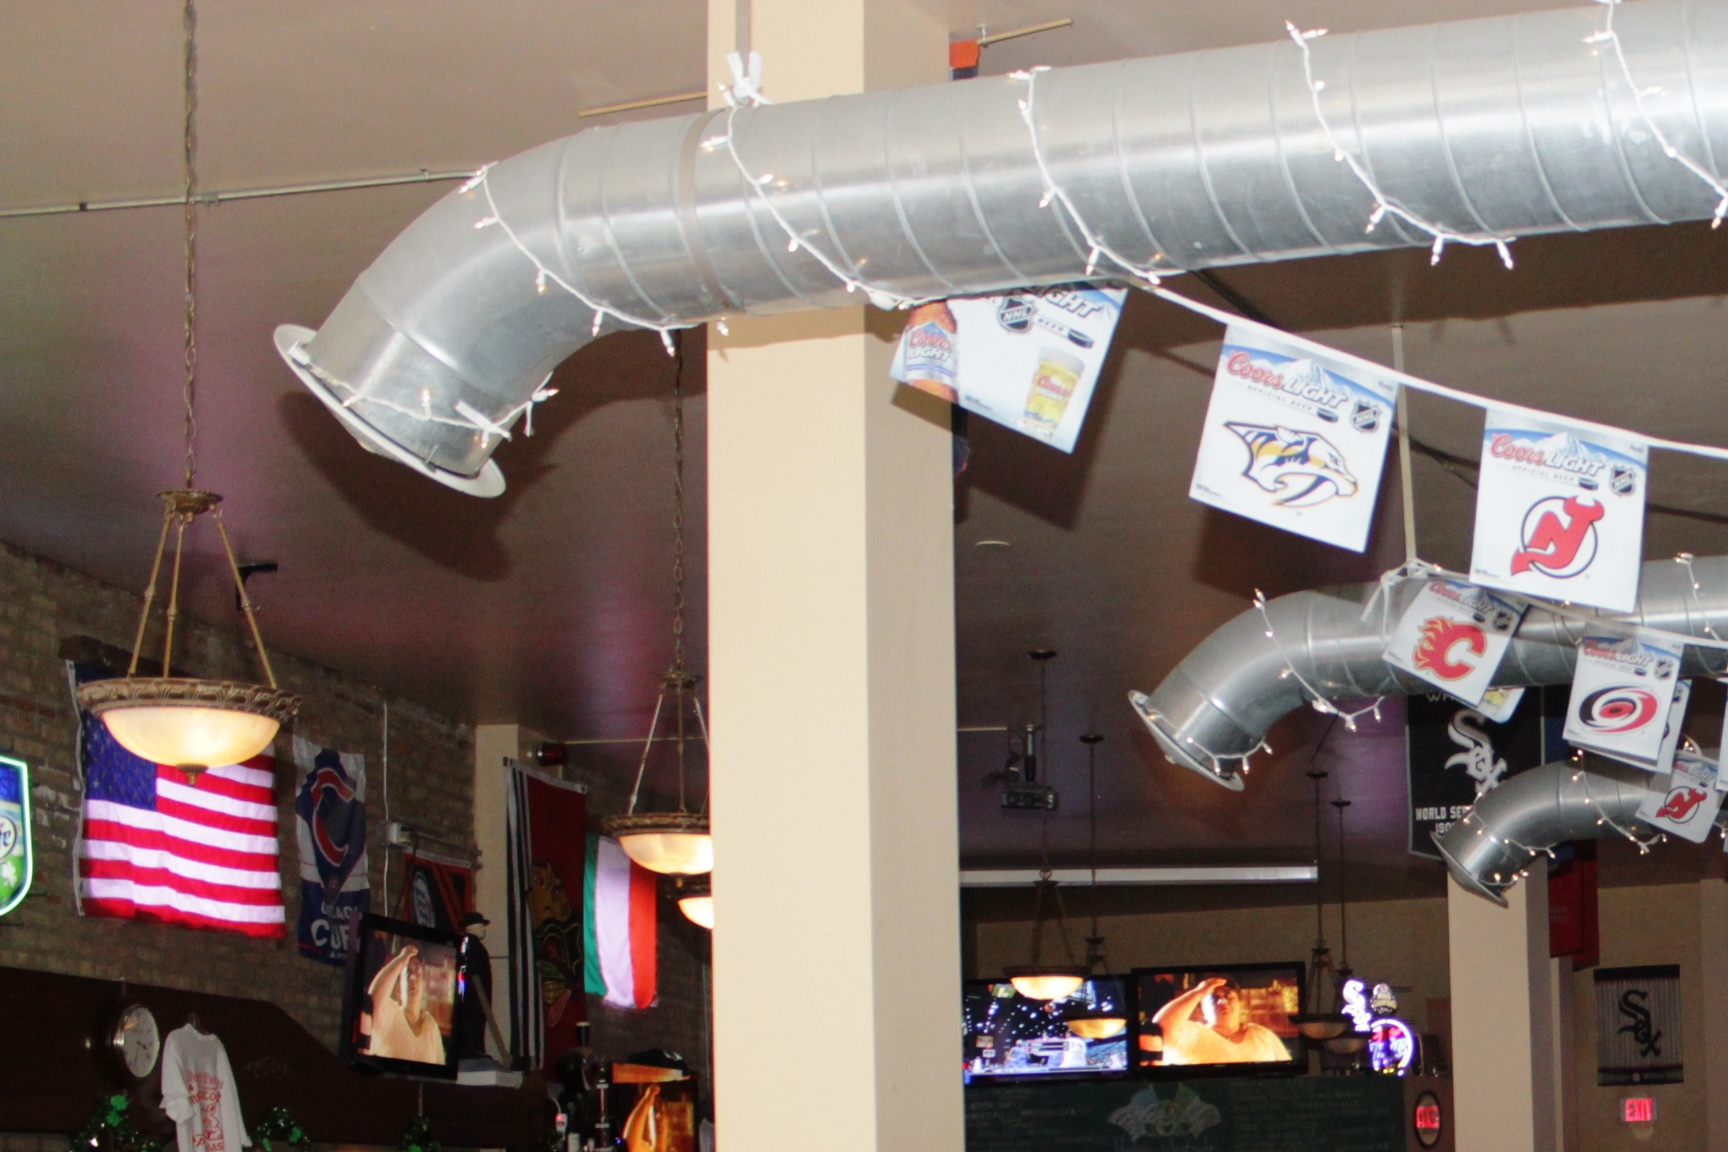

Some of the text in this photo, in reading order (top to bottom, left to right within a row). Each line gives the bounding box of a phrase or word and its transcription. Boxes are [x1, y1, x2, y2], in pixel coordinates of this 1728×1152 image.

[909, 330, 951, 350] Coors
[1227, 350, 1348, 409] Coors LIGHT
[1490, 433, 1605, 476] Coors LIGHT
[1583, 639, 1653, 668] Coors LIGHT
[1415, 807, 1447, 821] WORLD
[1625, 1098, 1653, 1122] EXIT
